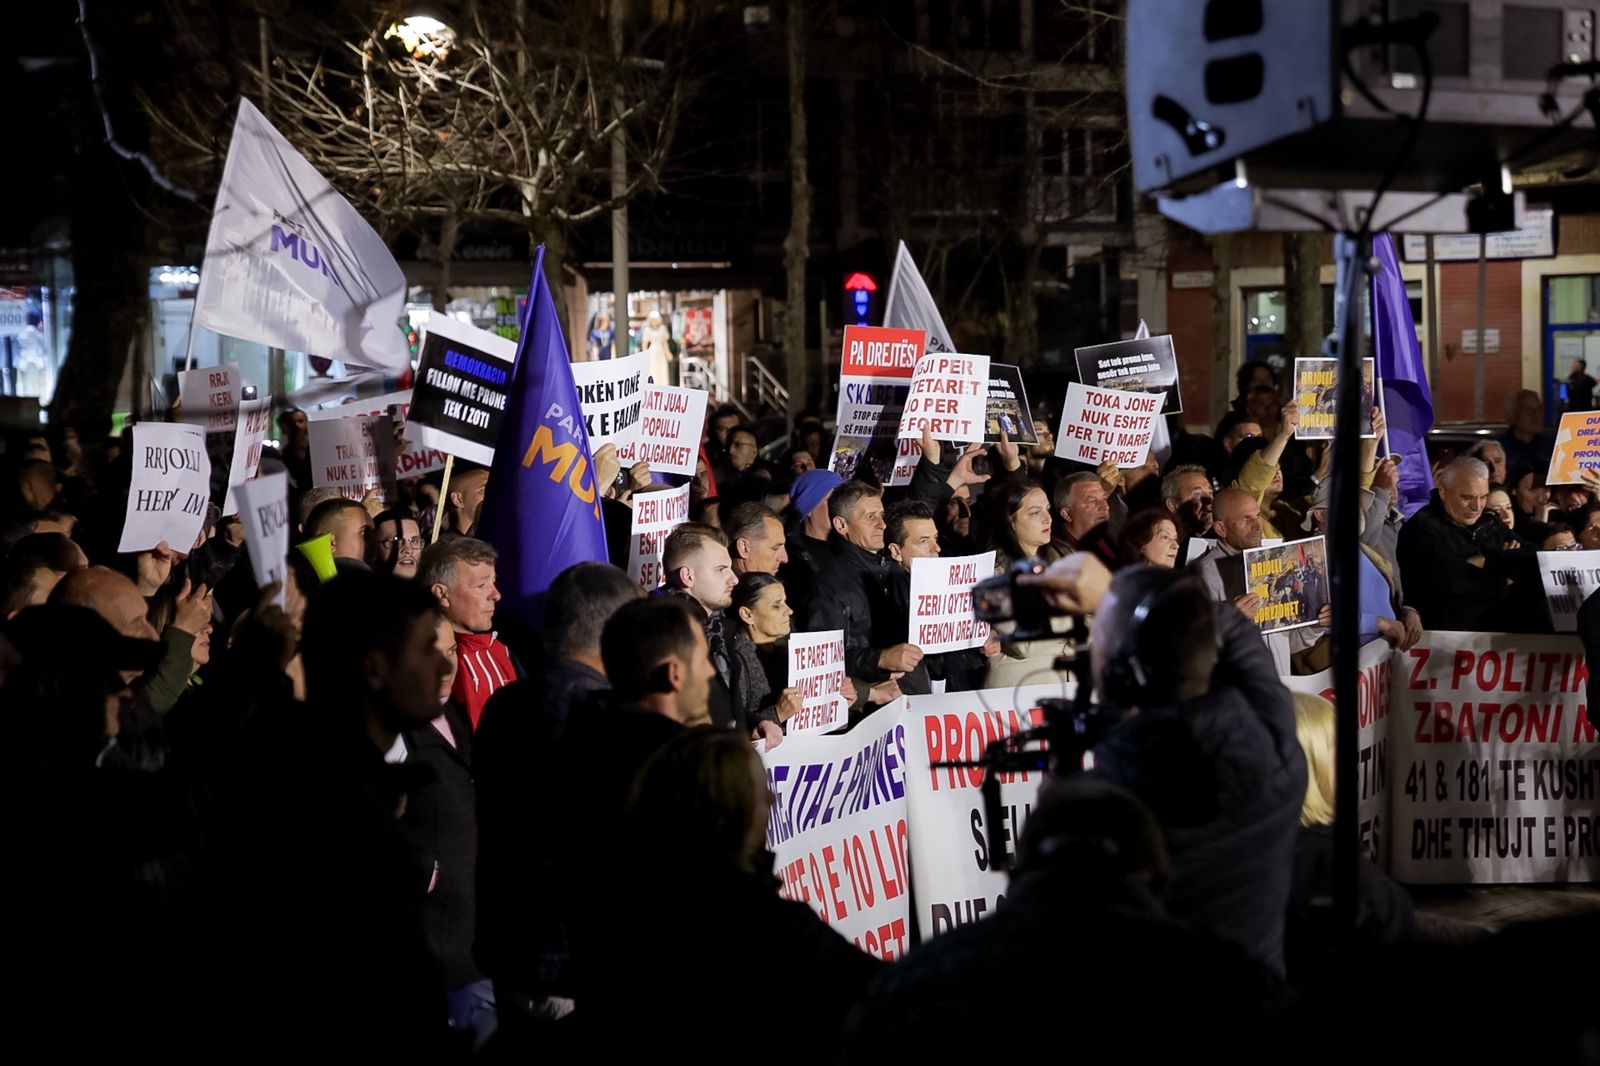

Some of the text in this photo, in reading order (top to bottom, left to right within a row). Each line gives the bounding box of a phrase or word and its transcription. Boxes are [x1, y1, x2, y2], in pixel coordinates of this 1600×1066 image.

[592, 237, 727, 257] RDRIGO
[849, 339, 918, 368] PA DREJTËSI
[939, 359, 974, 375] PER
[426, 367, 507, 411] FILLON ME PRONE
[617, 370, 641, 400] TONË
[443, 399, 490, 429] TEK I ZOTI
[663, 390, 689, 414] JUAJ
[904, 398, 959, 414] JO PER
[1086, 391, 1157, 412] TOKA JONE
[600, 413, 610, 436] E
[613, 400, 642, 434] FALIM
[641, 416, 681, 439] POPULLI
[908, 417, 972, 435] FORTIT
[1080, 409, 1151, 430] NUK ESHTE
[1066, 424, 1151, 447] PER TU MARRE
[639, 443, 692, 467] OLIGARKET
[1078, 444, 1138, 464] ME FORCE
[521, 424, 600, 523] MU
[638, 499, 659, 524] ZERI
[660, 500, 664, 521] I
[640, 562, 653, 586] SE
[948, 562, 977, 586] RRJOLL
[1550, 567, 1585, 586] TOKËN
[917, 594, 941, 616] ZERI
[942, 593, 947, 615] I
[919, 620, 954, 645] KERKON
[794, 647, 806, 670] TE
[807, 643, 829, 669] PARET
[1408, 648, 1438, 690] Z.
[793, 706, 810, 731] PER
[1413, 701, 1564, 743] ZBATONI
[821, 756, 853, 825] E
[1404, 760, 1427, 802] 41
[1435, 760, 1448, 802] &
[1456, 759, 1490, 801] 181
[1498, 759, 1527, 801] TE
[1411, 818, 1453, 859] DHE
[1459, 817, 1537, 858] TITUJT
[1543, 816, 1557, 857] E
[809, 852, 830, 924] 9
[822, 845, 848, 921] E
[843, 834, 876, 912] 10
